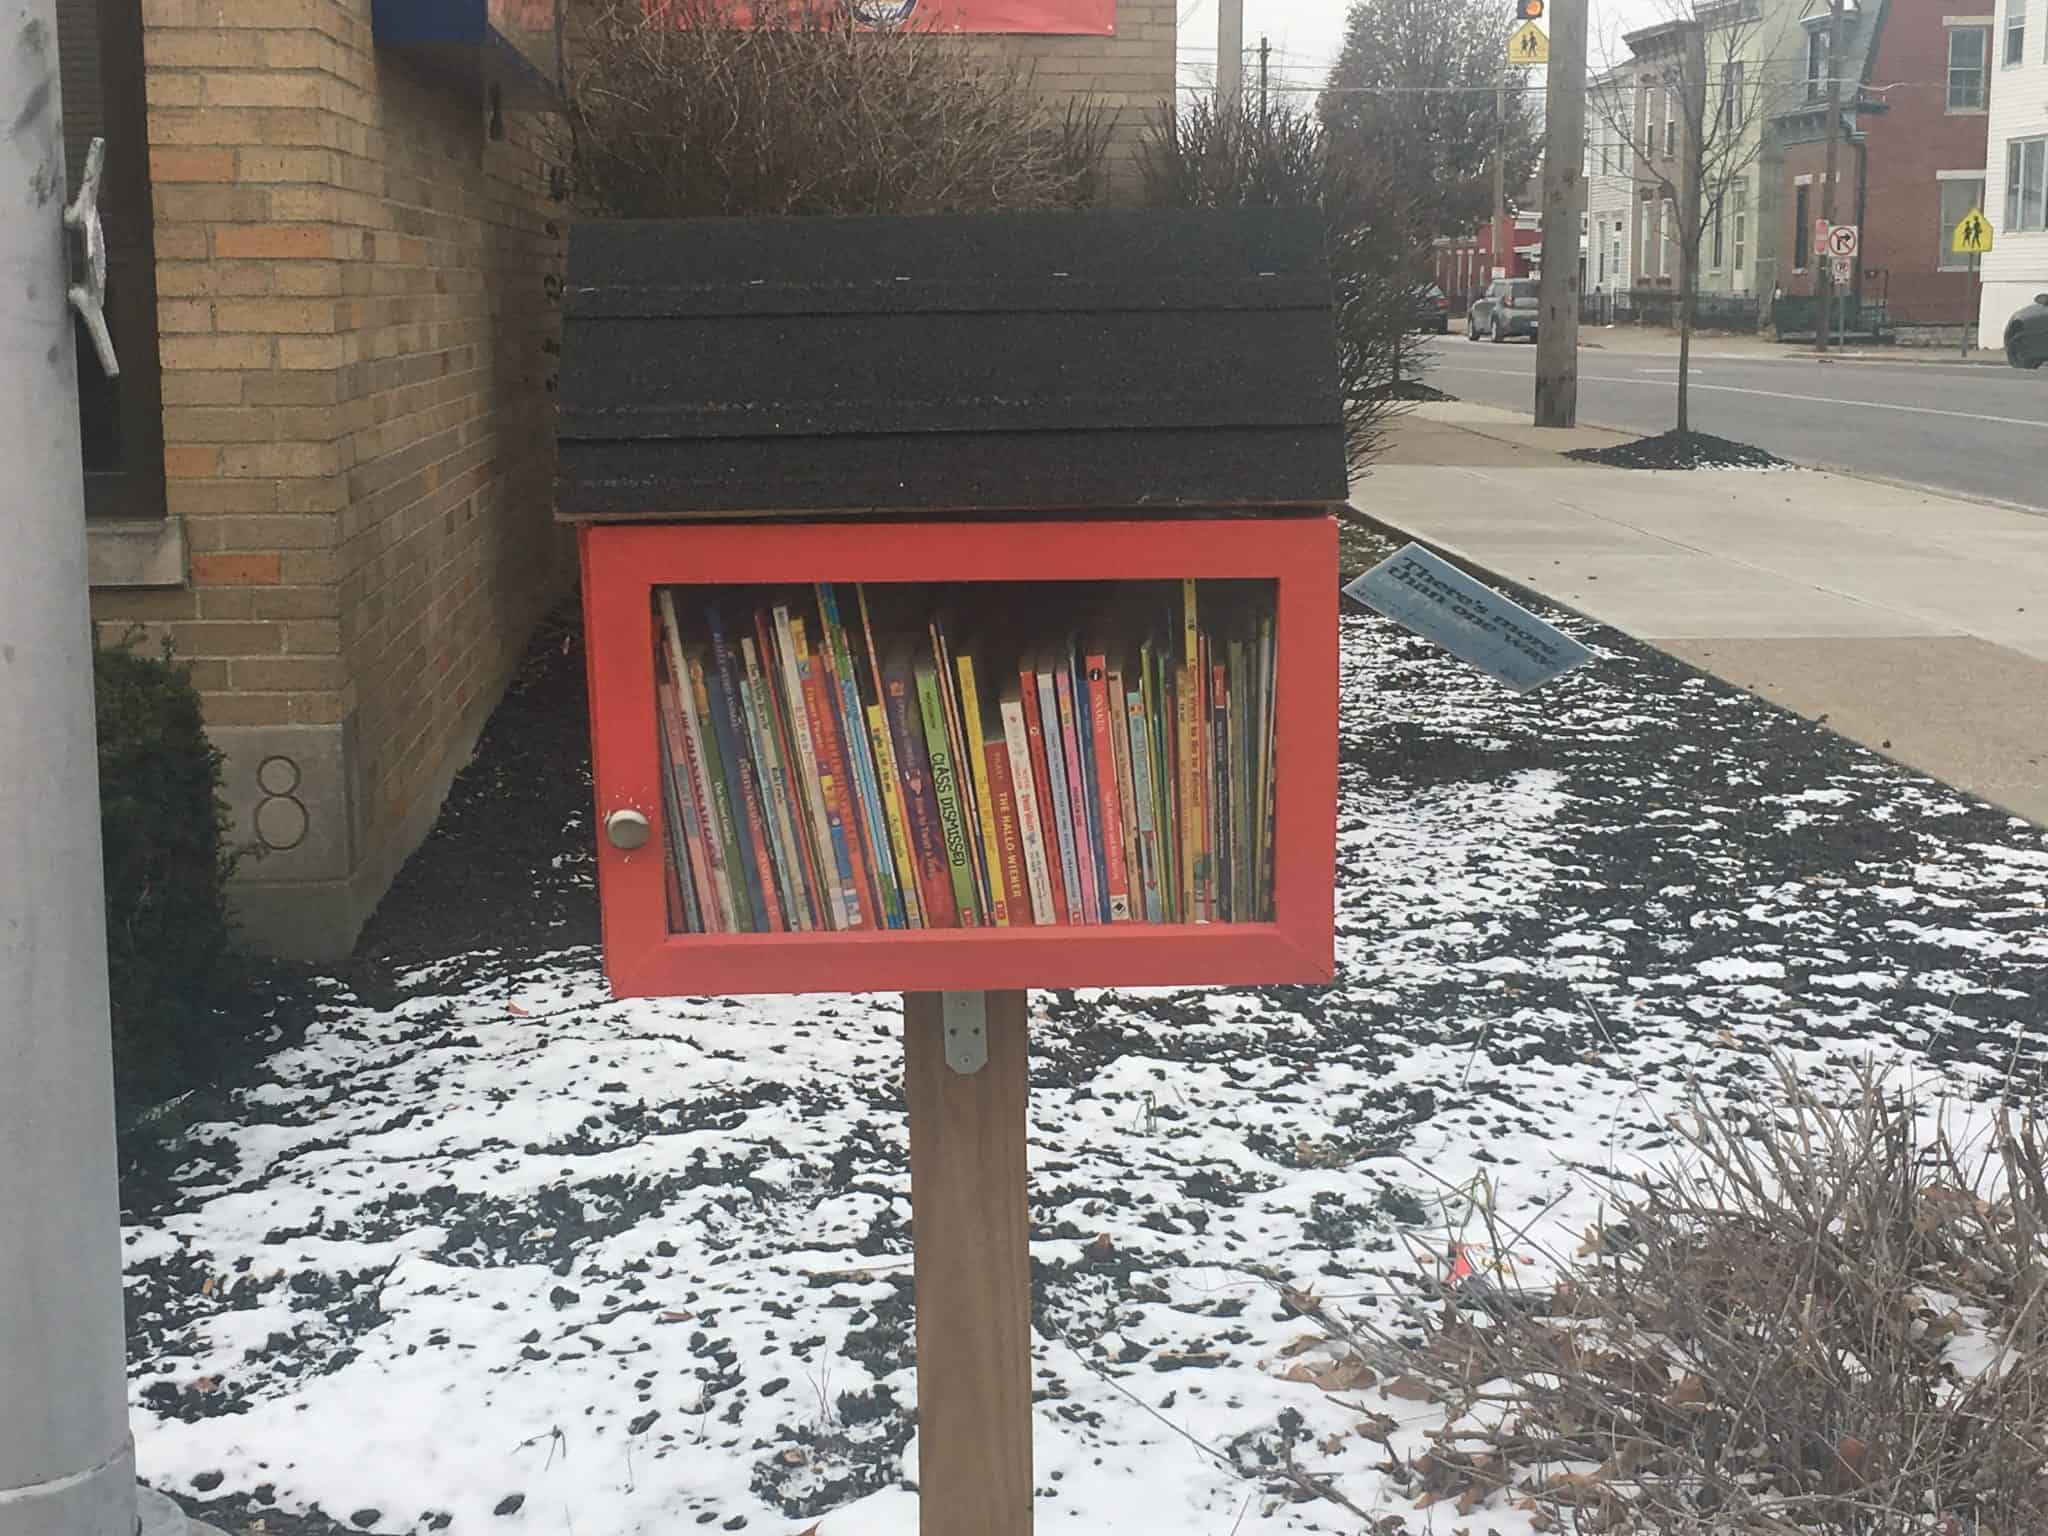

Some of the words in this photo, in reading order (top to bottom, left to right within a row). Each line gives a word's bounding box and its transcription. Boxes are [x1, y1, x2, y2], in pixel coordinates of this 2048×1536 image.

[1400, 556, 1488, 615] There's
[1492, 614, 1559, 655] more
[1450, 603, 1498, 632] one
[256, 755, 309, 850] 8
[931, 752, 951, 794] CLASS
[999, 792, 1010, 814] THE
[940, 796, 966, 867] DISMISSED
[1002, 815, 1022, 897] HALLO-WIENER
